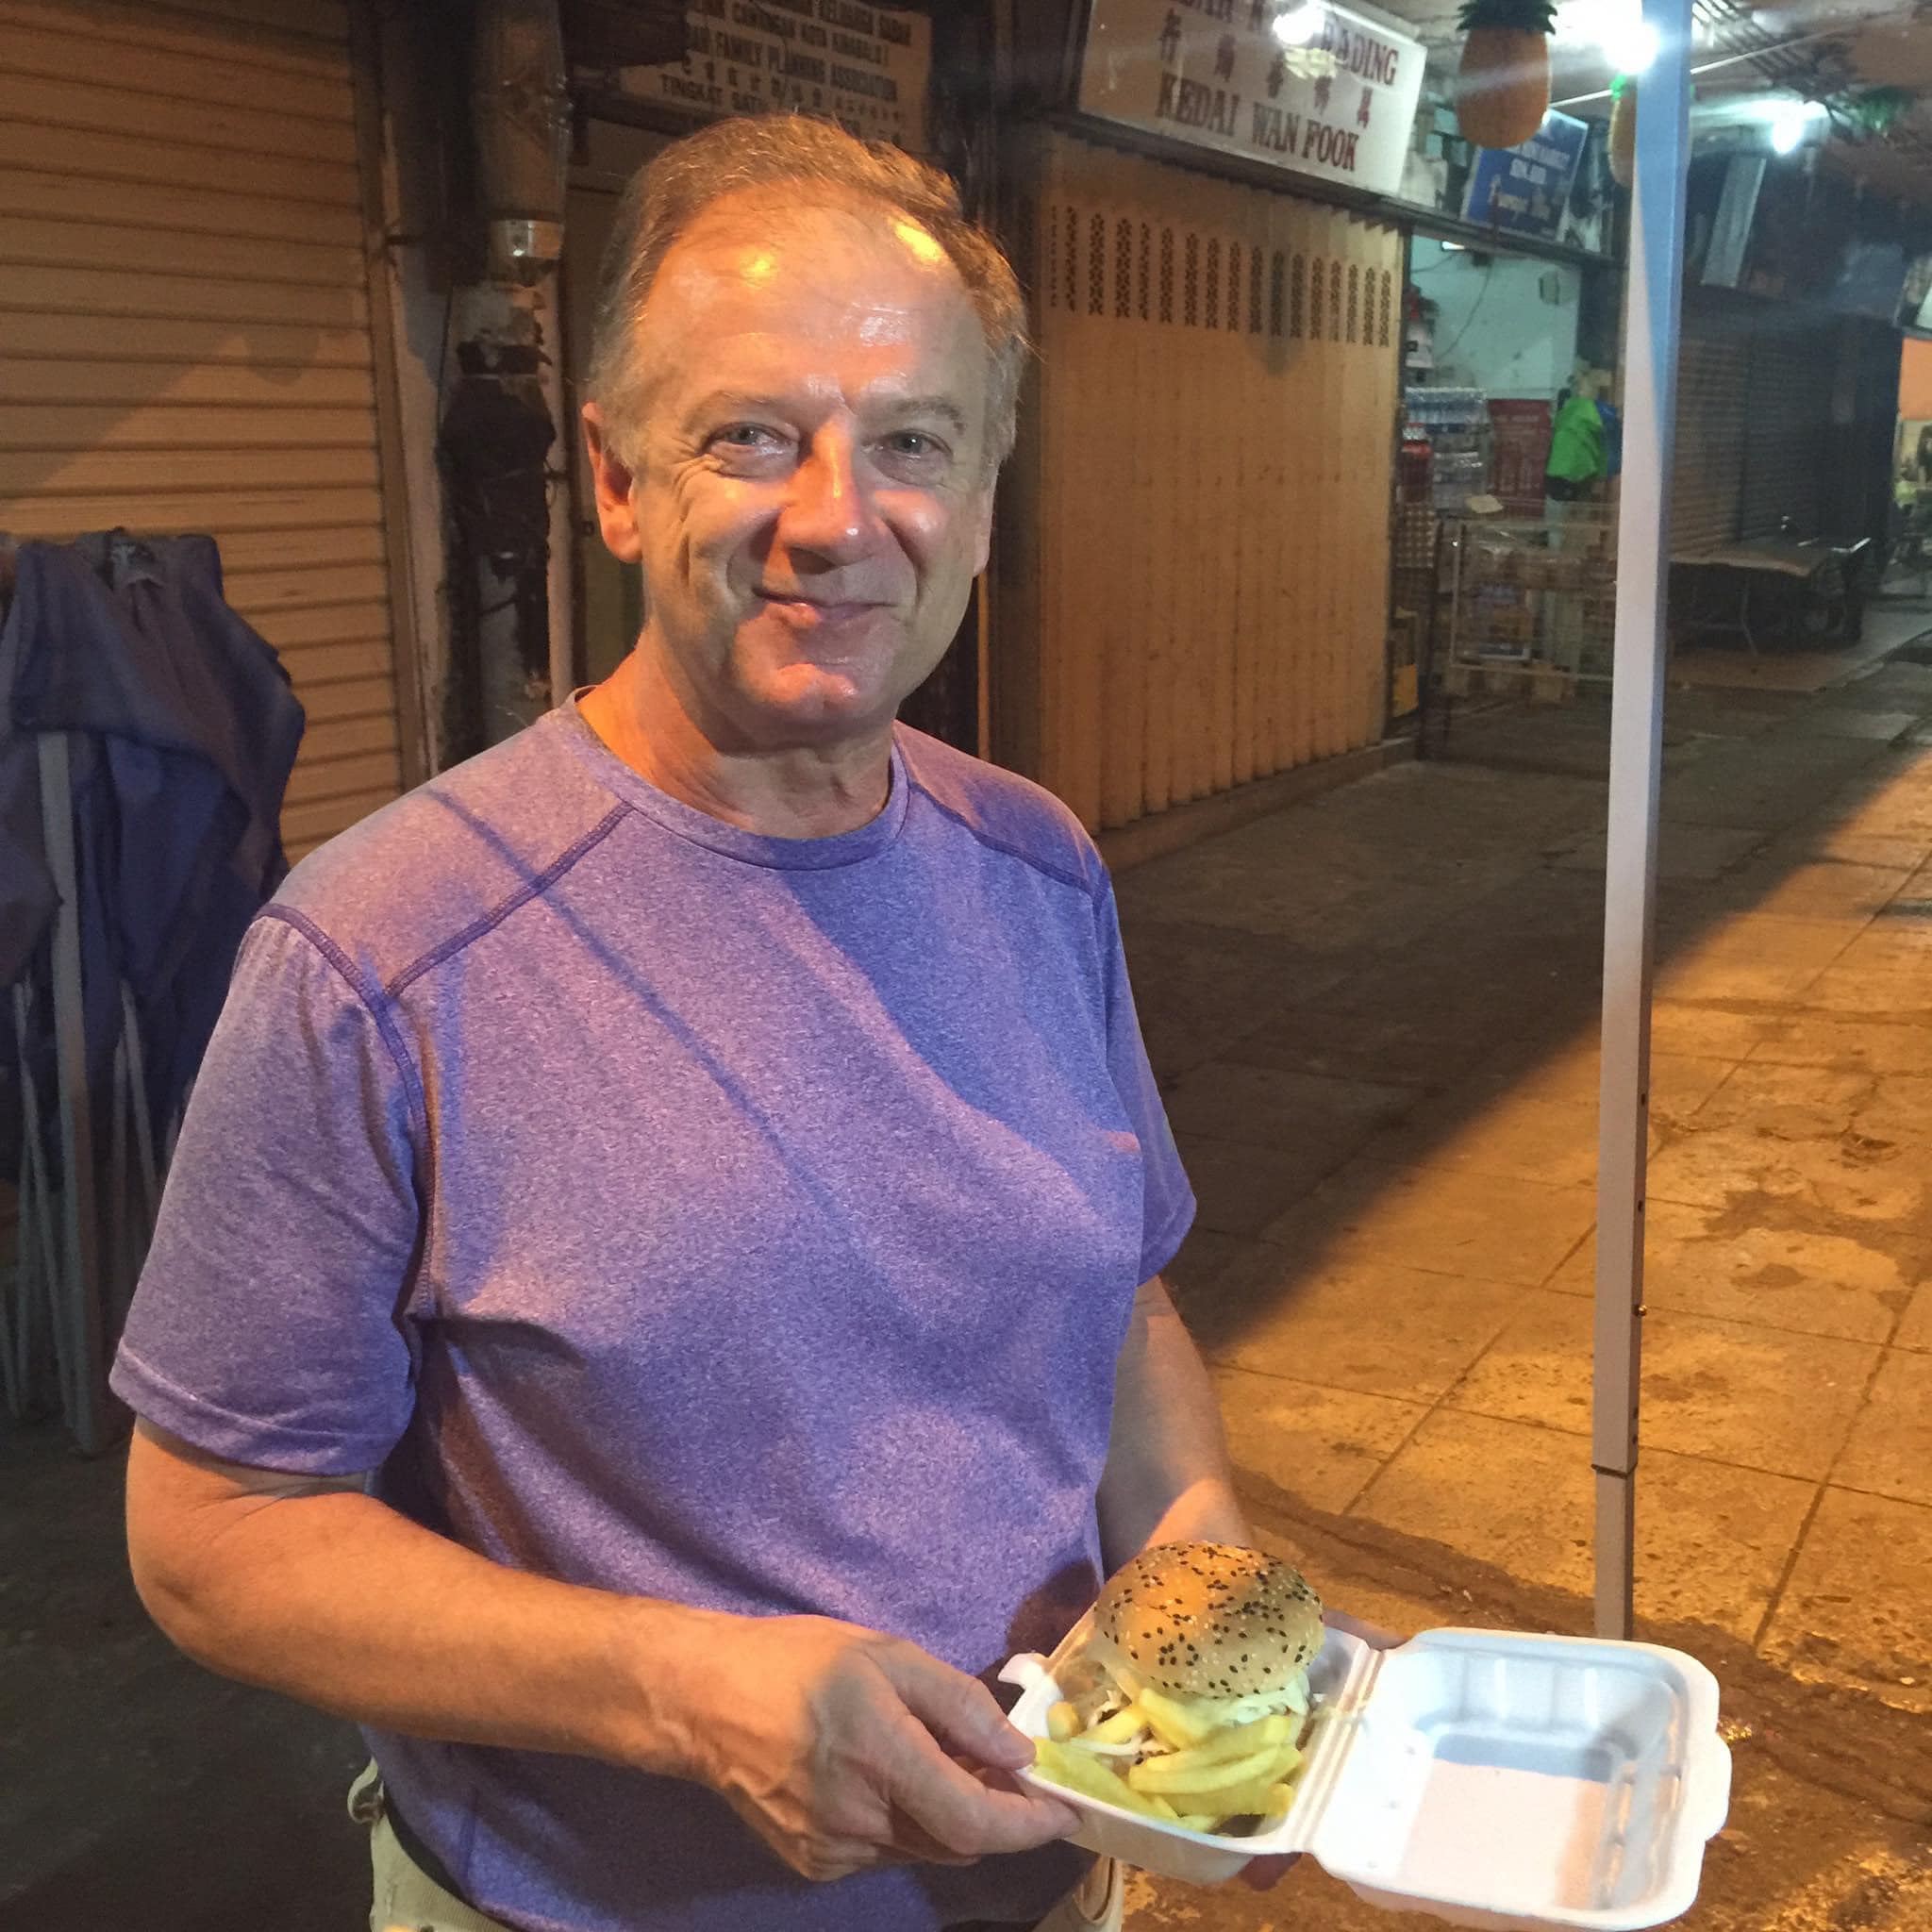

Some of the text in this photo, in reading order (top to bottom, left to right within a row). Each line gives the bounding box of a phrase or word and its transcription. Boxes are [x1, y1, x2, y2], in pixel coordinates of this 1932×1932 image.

[1309, 15, 1399, 86] RADING
[1154, 72, 1241, 138] KEDAI
[1252, 101, 1301, 154] WAN
[1302, 118, 1359, 172] FOOK
